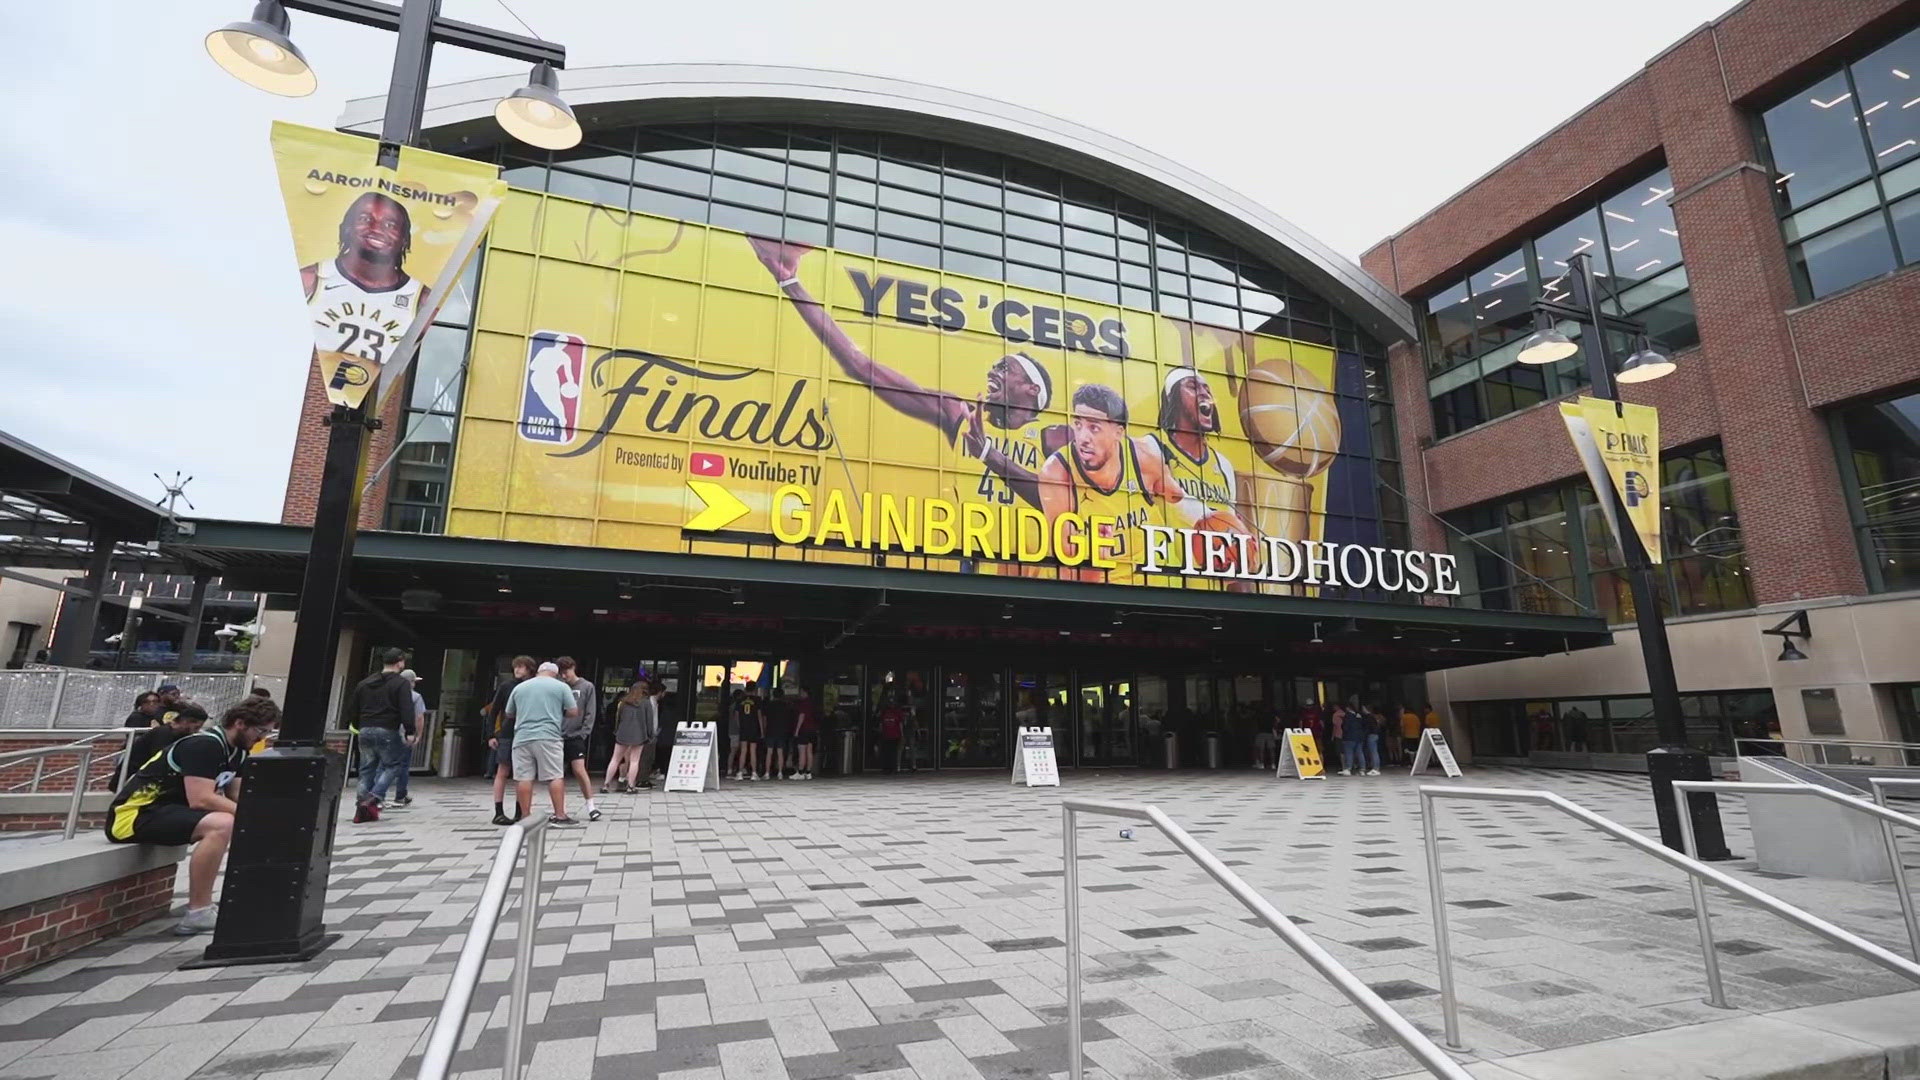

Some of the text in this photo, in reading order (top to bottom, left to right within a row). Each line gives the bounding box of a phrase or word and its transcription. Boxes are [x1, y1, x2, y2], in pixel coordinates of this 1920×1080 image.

[307, 168, 457, 207] AARON NESMITH
[846, 267, 965, 332] YES
[315, 301, 402, 344] INDIANA
[336, 322, 385, 366] 23
[545, 349, 833, 458] Finals
[527, 416, 555, 436] NBA
[615, 447, 821, 486] Presented by YouTube TV
[771, 484, 1461, 596] GAINBRIDGE FIELDHOUSE
